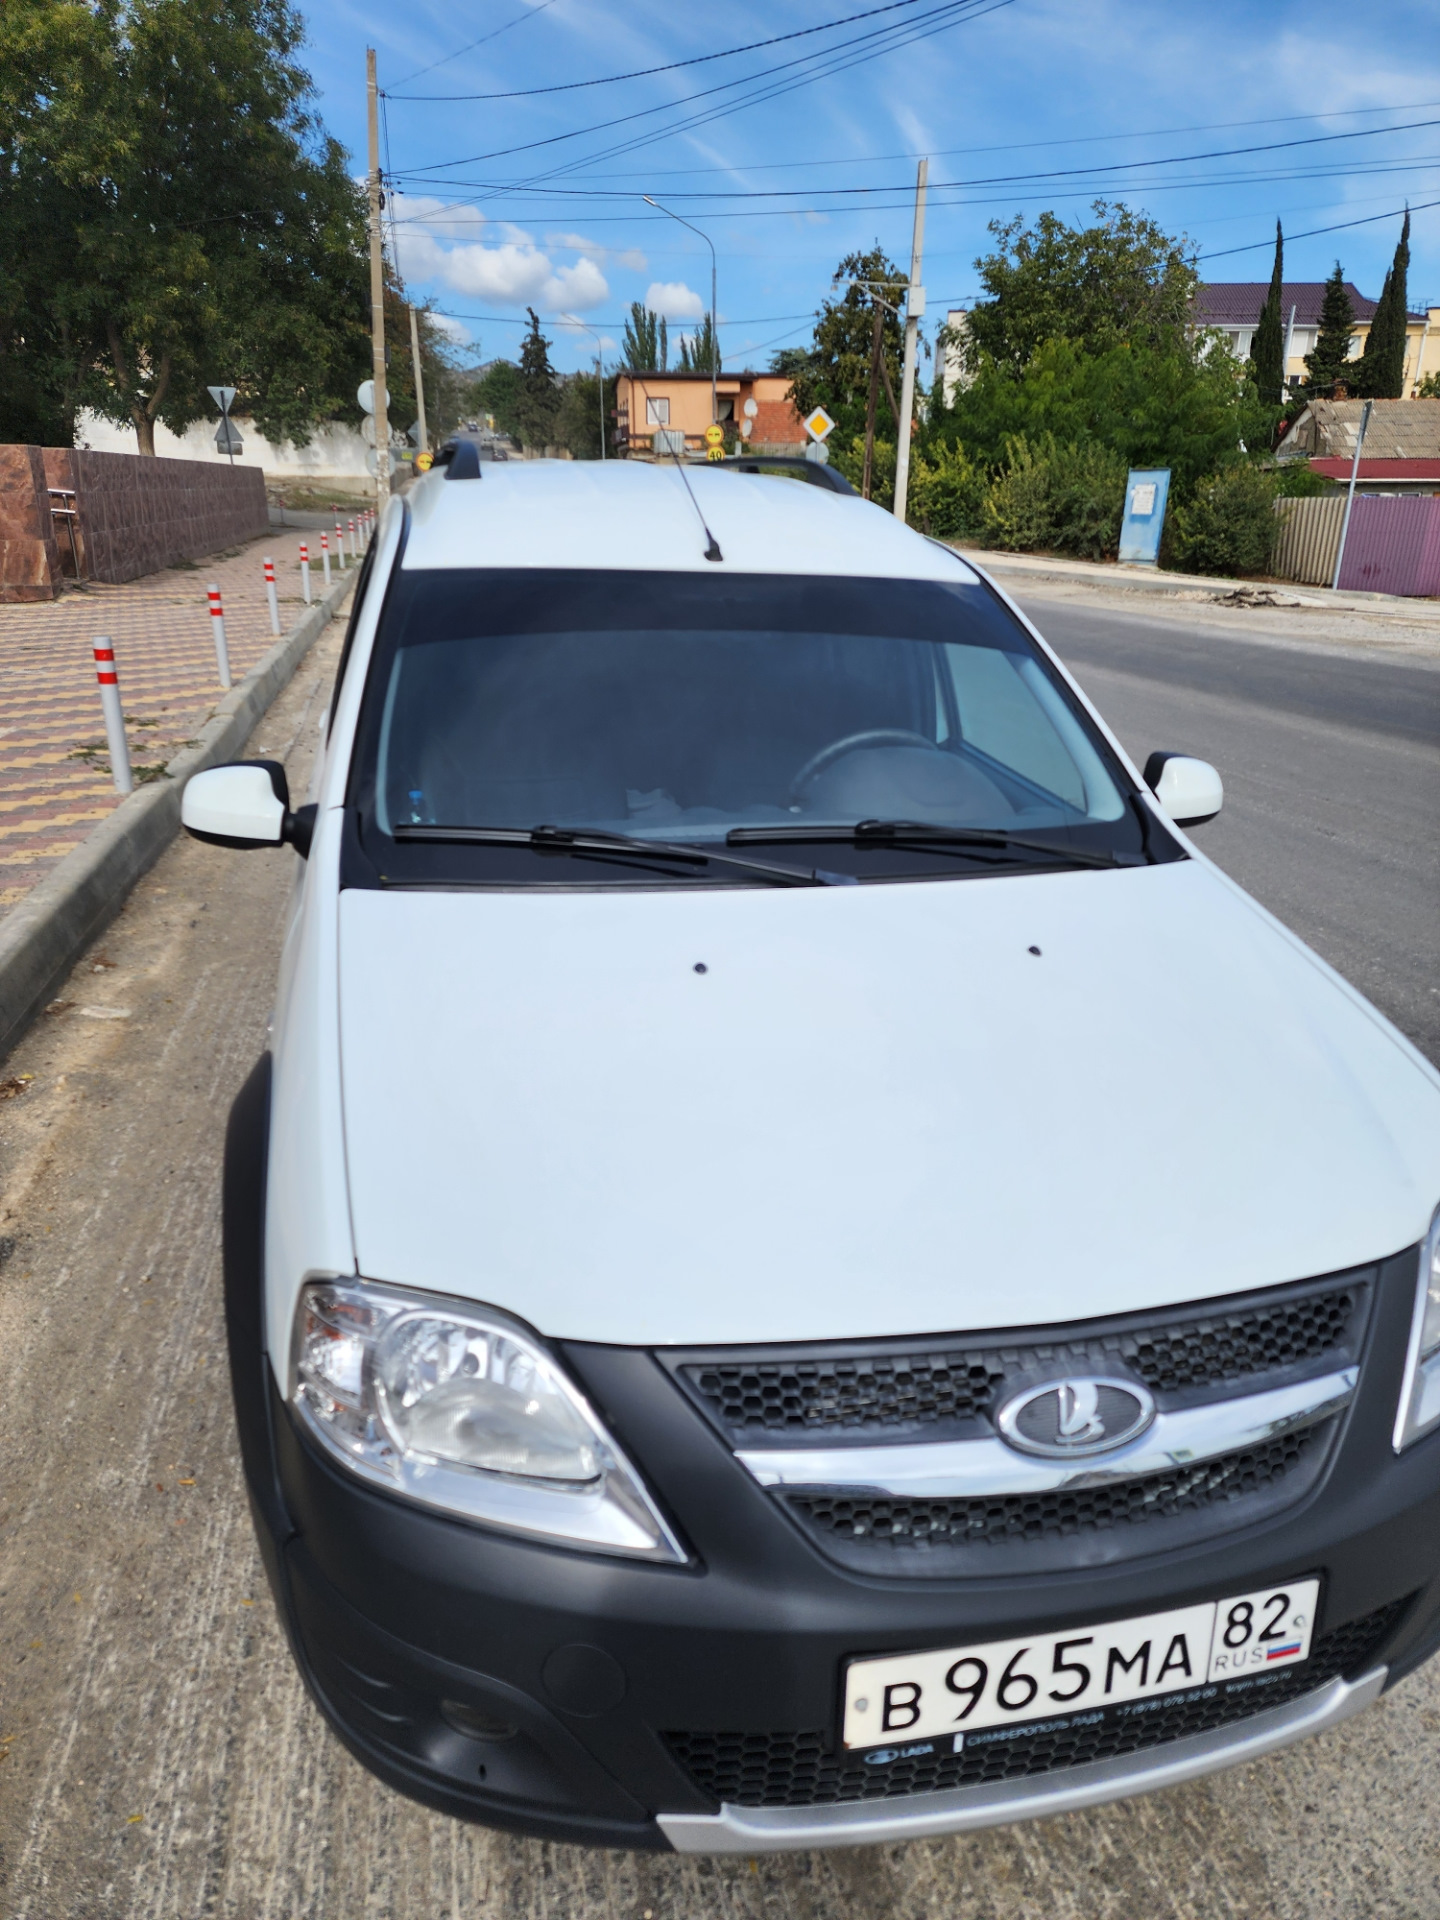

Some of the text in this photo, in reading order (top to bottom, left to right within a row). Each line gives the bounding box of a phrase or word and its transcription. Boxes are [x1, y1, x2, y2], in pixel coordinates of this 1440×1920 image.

[710, 450, 722, 461] 40
[1222, 1593, 1291, 1648] 82
[1214, 1646, 1264, 1673] RUS
